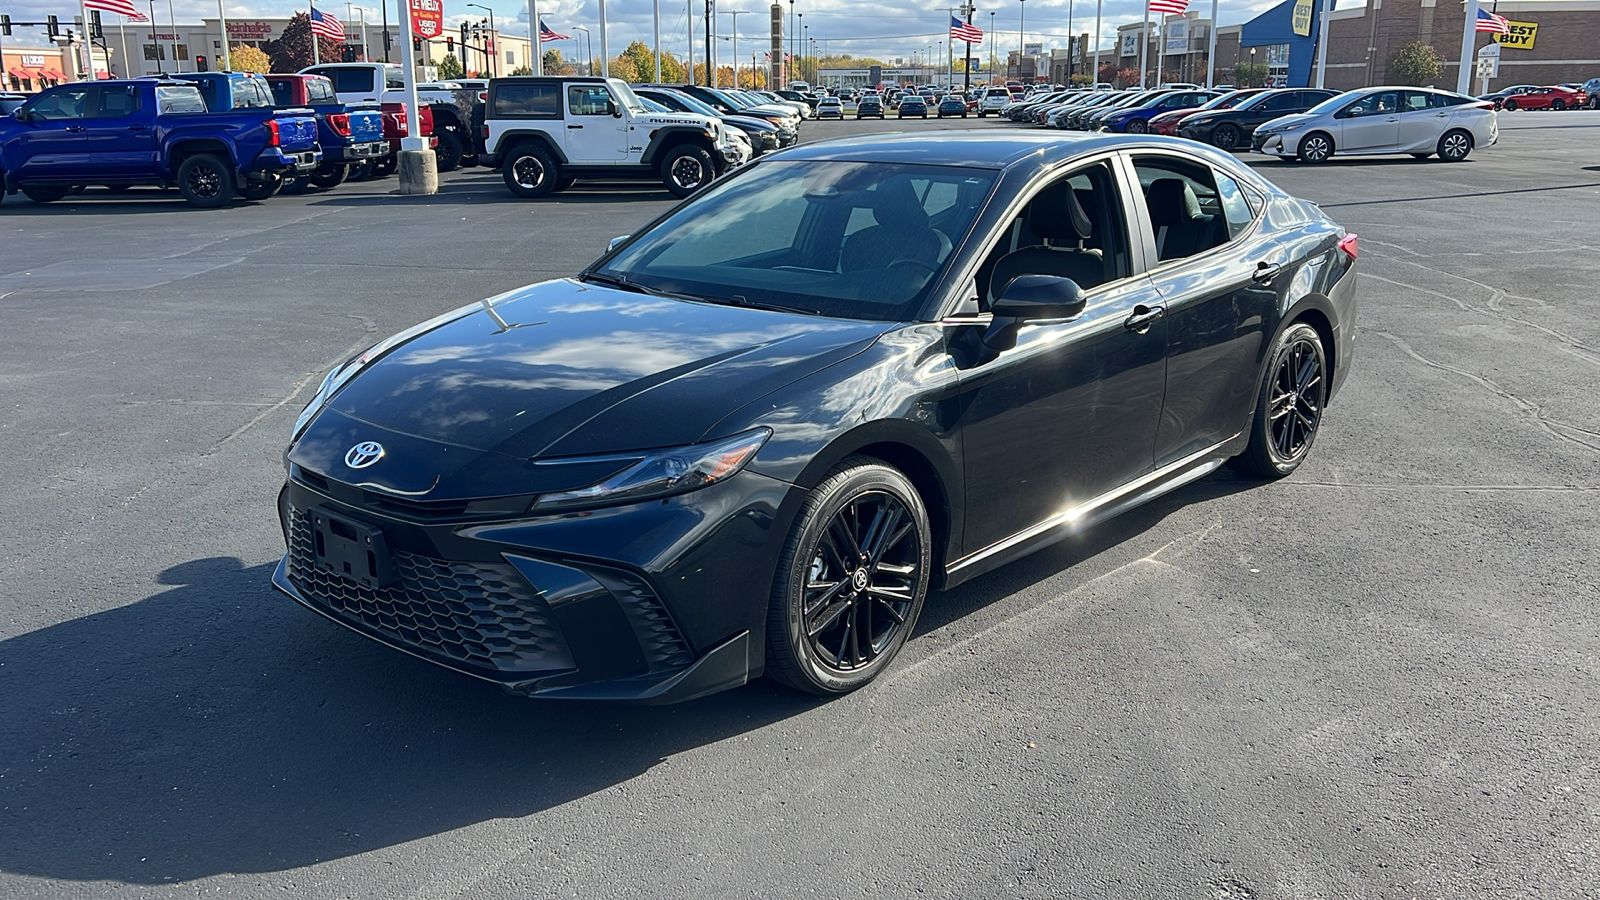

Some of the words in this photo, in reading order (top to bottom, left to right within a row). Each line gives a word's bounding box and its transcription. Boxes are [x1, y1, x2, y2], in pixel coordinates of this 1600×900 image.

[412, 0, 420, 9] LE
[421, 0, 440, 12] MIEUX
[1295, 4, 1312, 16] BEST
[418, 20, 437, 29] USED
[1295, 17, 1308, 29] BUY
[421, 27, 436, 36] CARS
[1500, 34, 1531, 45] BUY
